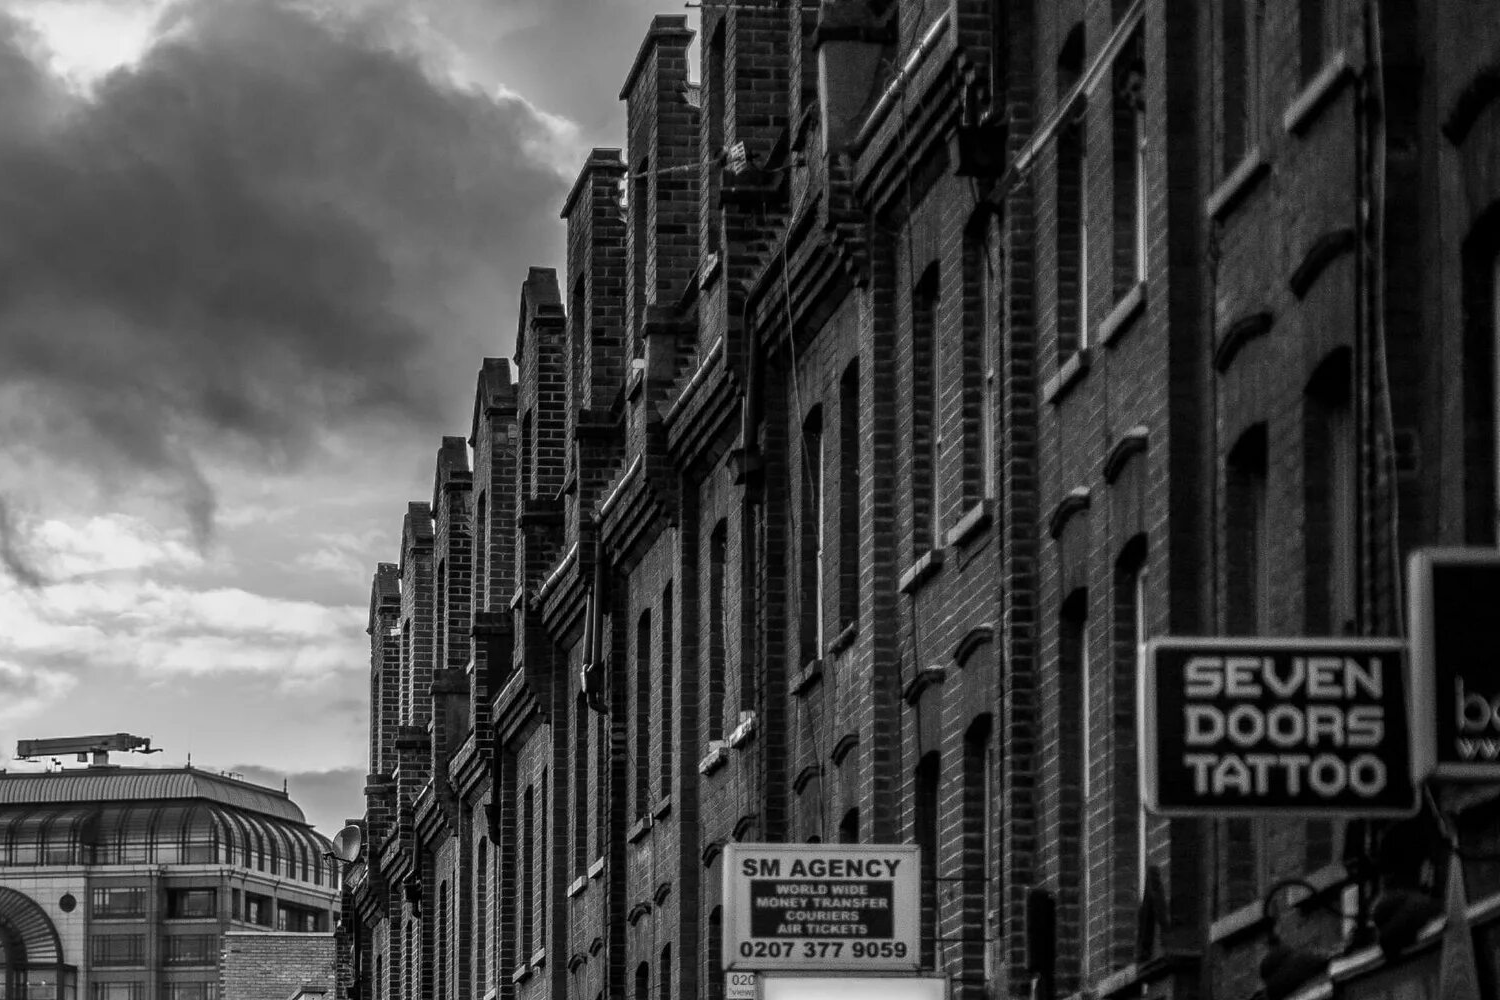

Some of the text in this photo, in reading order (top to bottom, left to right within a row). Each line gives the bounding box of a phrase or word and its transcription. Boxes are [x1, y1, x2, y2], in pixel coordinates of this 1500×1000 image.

[1184, 656, 1384, 700] SEVEN
[1184, 703, 1386, 749] DOORS
[1182, 752, 1388, 798] TATTOO
[742, 859, 902, 877] SM AGENCY
[775, 884, 868, 895] WORLD WIDE
[755, 898, 888, 909] MONEY TRANSFER
[785, 911, 860, 921] COURIERS
[777, 924, 869, 935] AIR TICKETS
[740, 942, 907, 958] 0207 377 9059
